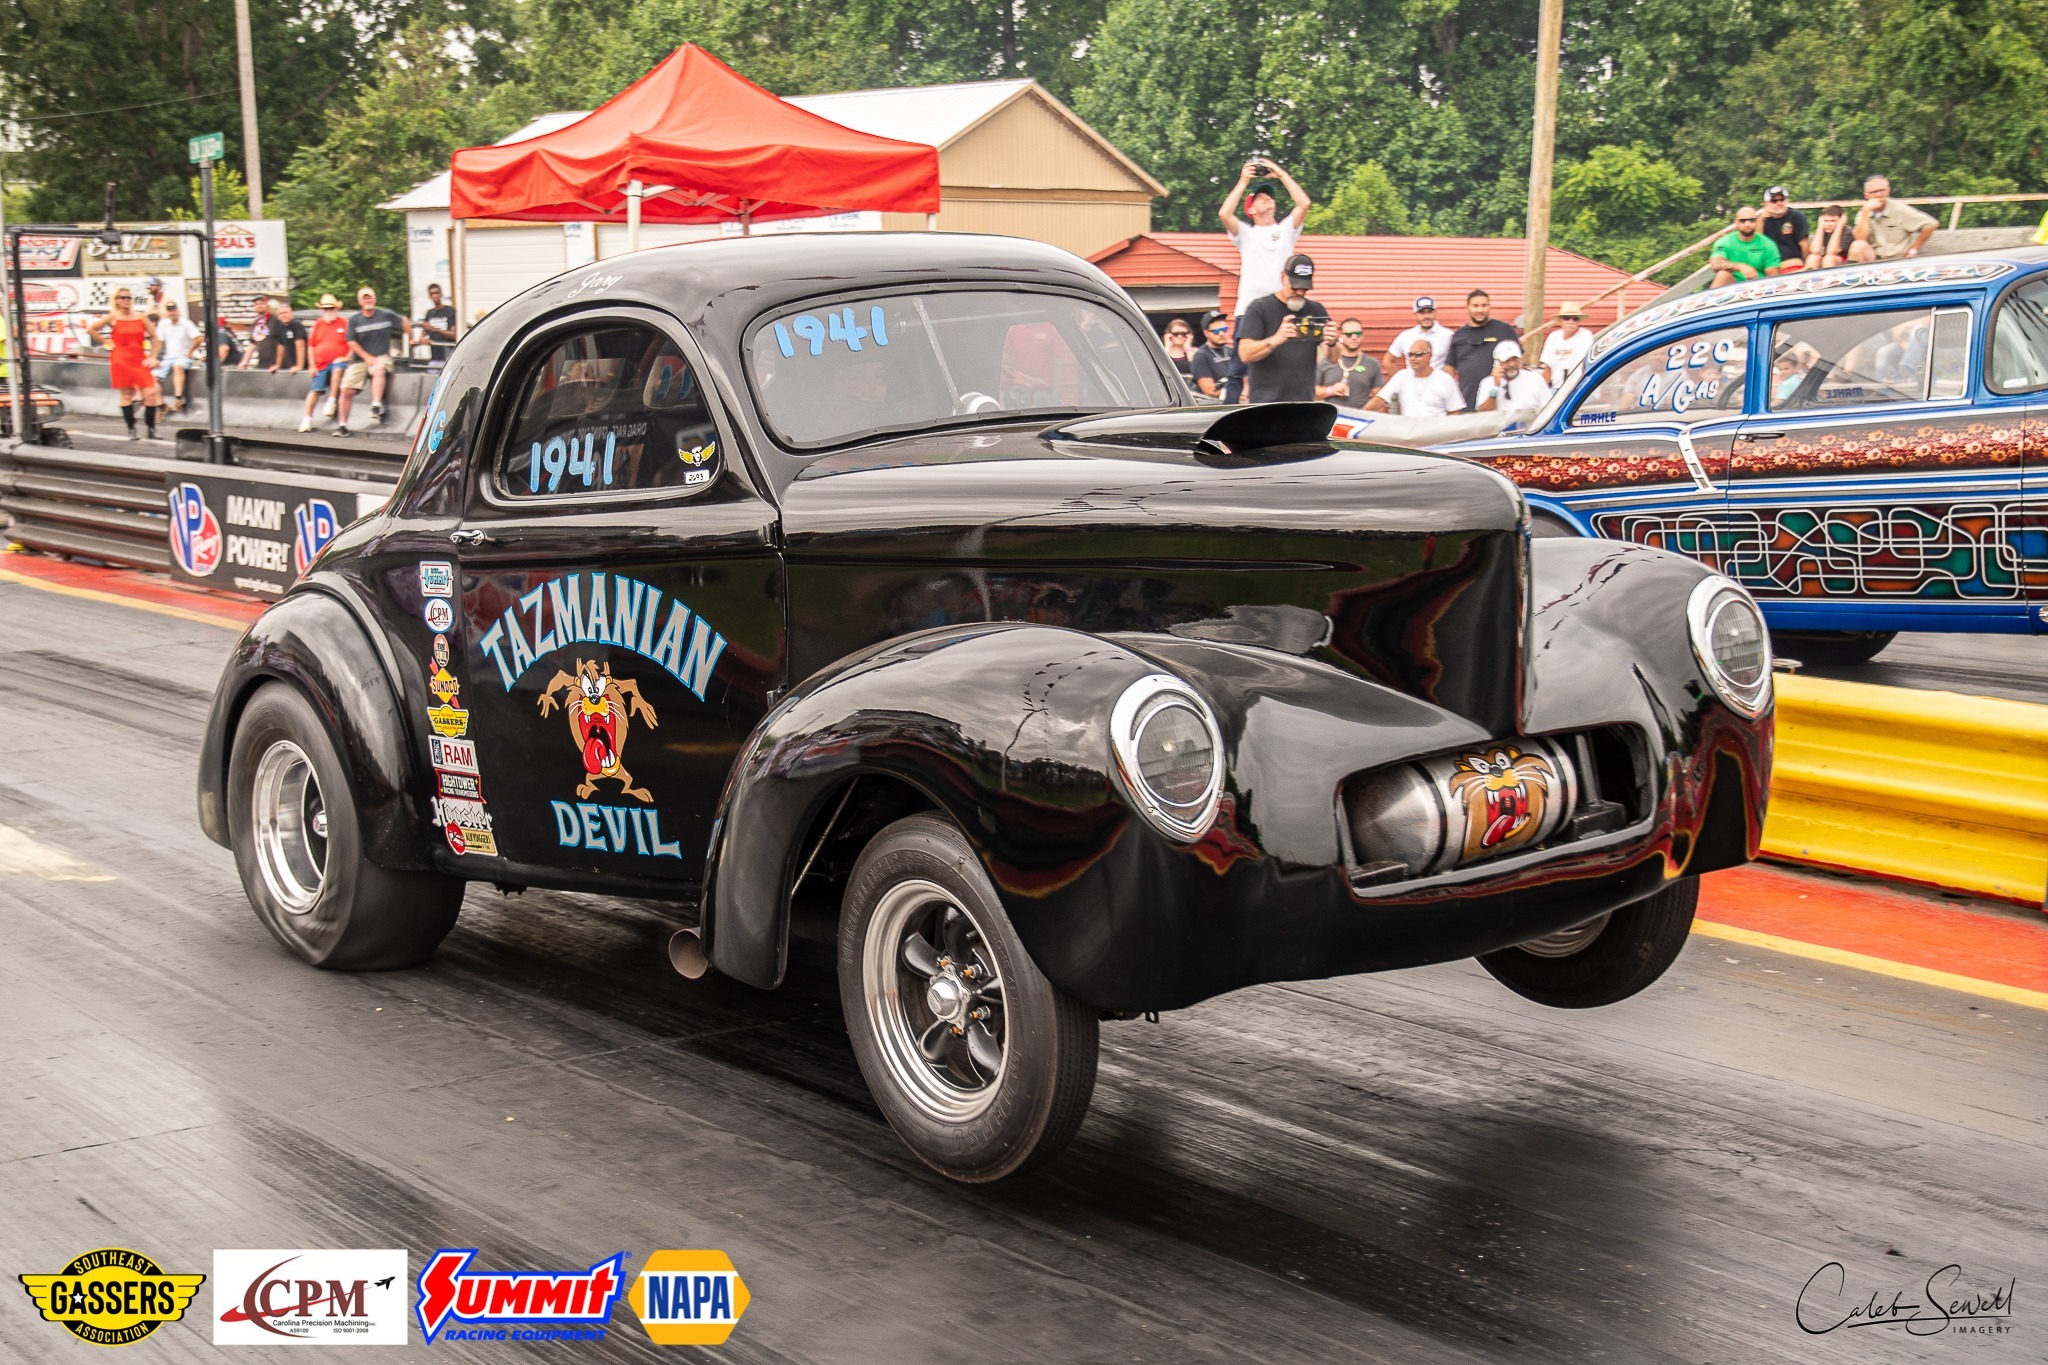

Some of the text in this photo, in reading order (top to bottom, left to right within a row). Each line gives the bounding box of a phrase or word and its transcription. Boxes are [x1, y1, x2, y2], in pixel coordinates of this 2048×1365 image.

[567, 271, 624, 299] Gary
[774, 305, 889, 358] 1941
[1665, 338, 1735, 372] 220
[1580, 411, 1617, 425] MAHLE
[530, 431, 616, 493] 1941
[226, 495, 286, 531] MAKIN'
[226, 534, 292, 573] POWER!
[432, 607, 449, 621] CPM
[480, 572, 728, 702] TAZMANIAN
[431, 678, 458, 693] SUNOCO
[434, 717, 464, 726] GASSERS
[443, 744, 474, 767] RAM
[441, 773, 477, 791] HIGHTOWER
[430, 795, 493, 833] Hoosier
[550, 800, 683, 860] DEVIL
